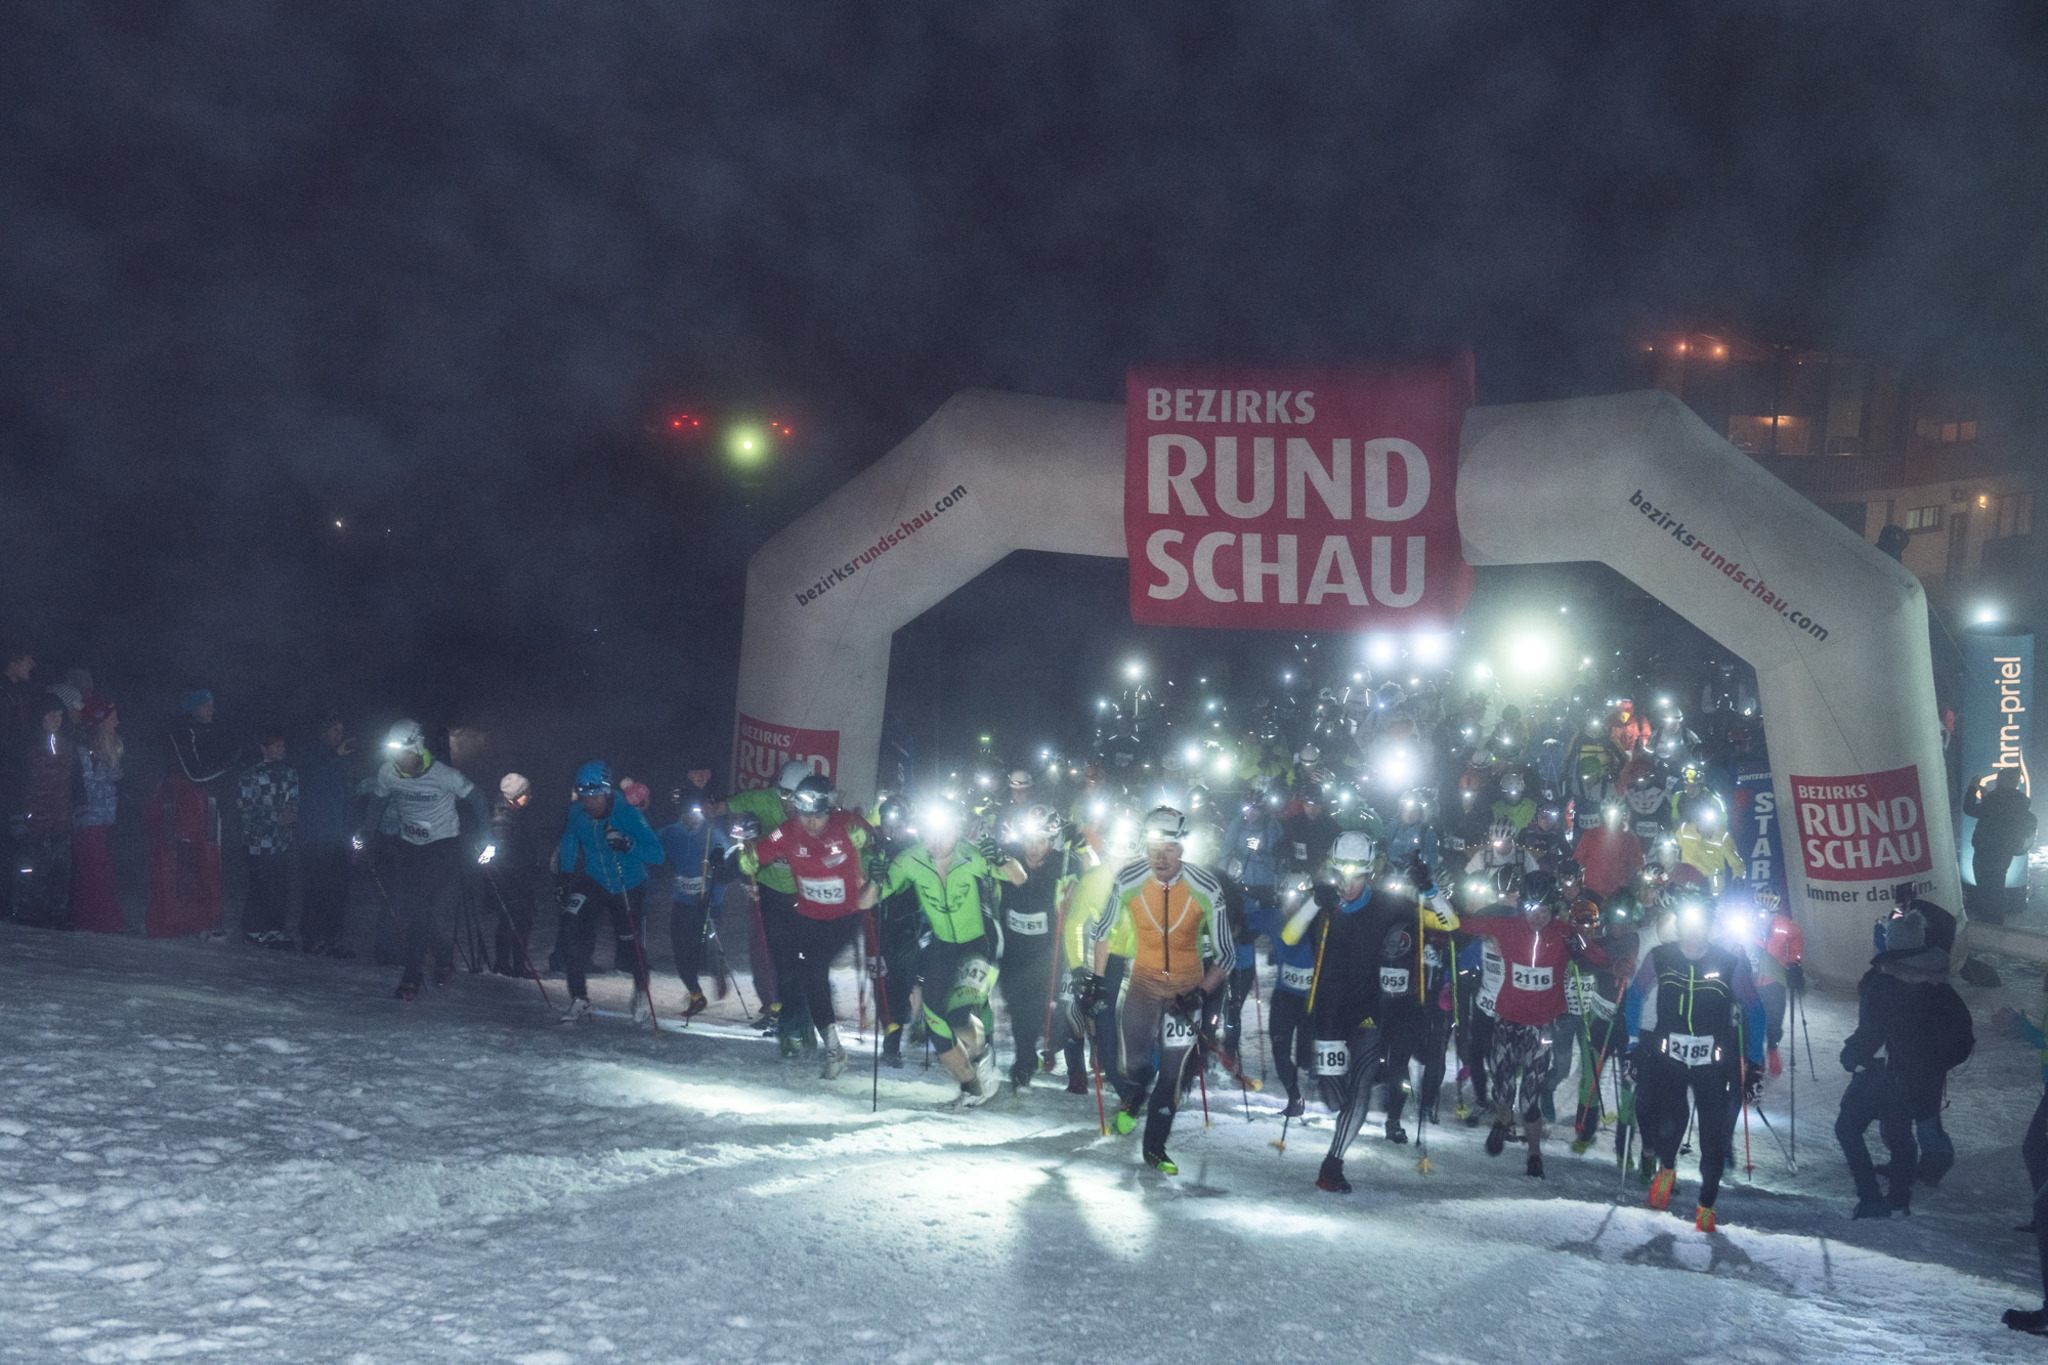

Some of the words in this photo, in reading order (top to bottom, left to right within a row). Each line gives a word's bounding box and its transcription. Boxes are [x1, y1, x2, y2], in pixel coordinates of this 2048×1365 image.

[1147, 388, 1316, 424] BEZIRKS
[1147, 433, 1431, 522] RUND
[795, 484, 968, 607] bezirksrundschau.com
[1146, 528, 1426, 608] SCHAU
[1629, 489, 1829, 642] bezirksrundschau.com
[741, 722, 791, 748] BEZIRKS
[740, 740, 831, 780] RUD
[1798, 783, 1868, 800] BEZIRKS
[1801, 796, 1917, 837] RUND
[1806, 831, 1922, 870] SCHAU
[806, 887, 843, 899] 2152
[1806, 883, 1859, 903] Immer
[1284, 971, 1313, 985] 2019
[1514, 971, 1550, 985] 2116
[1480, 996, 1496, 1012] 20
[1671, 1041, 1710, 1059] 2185
